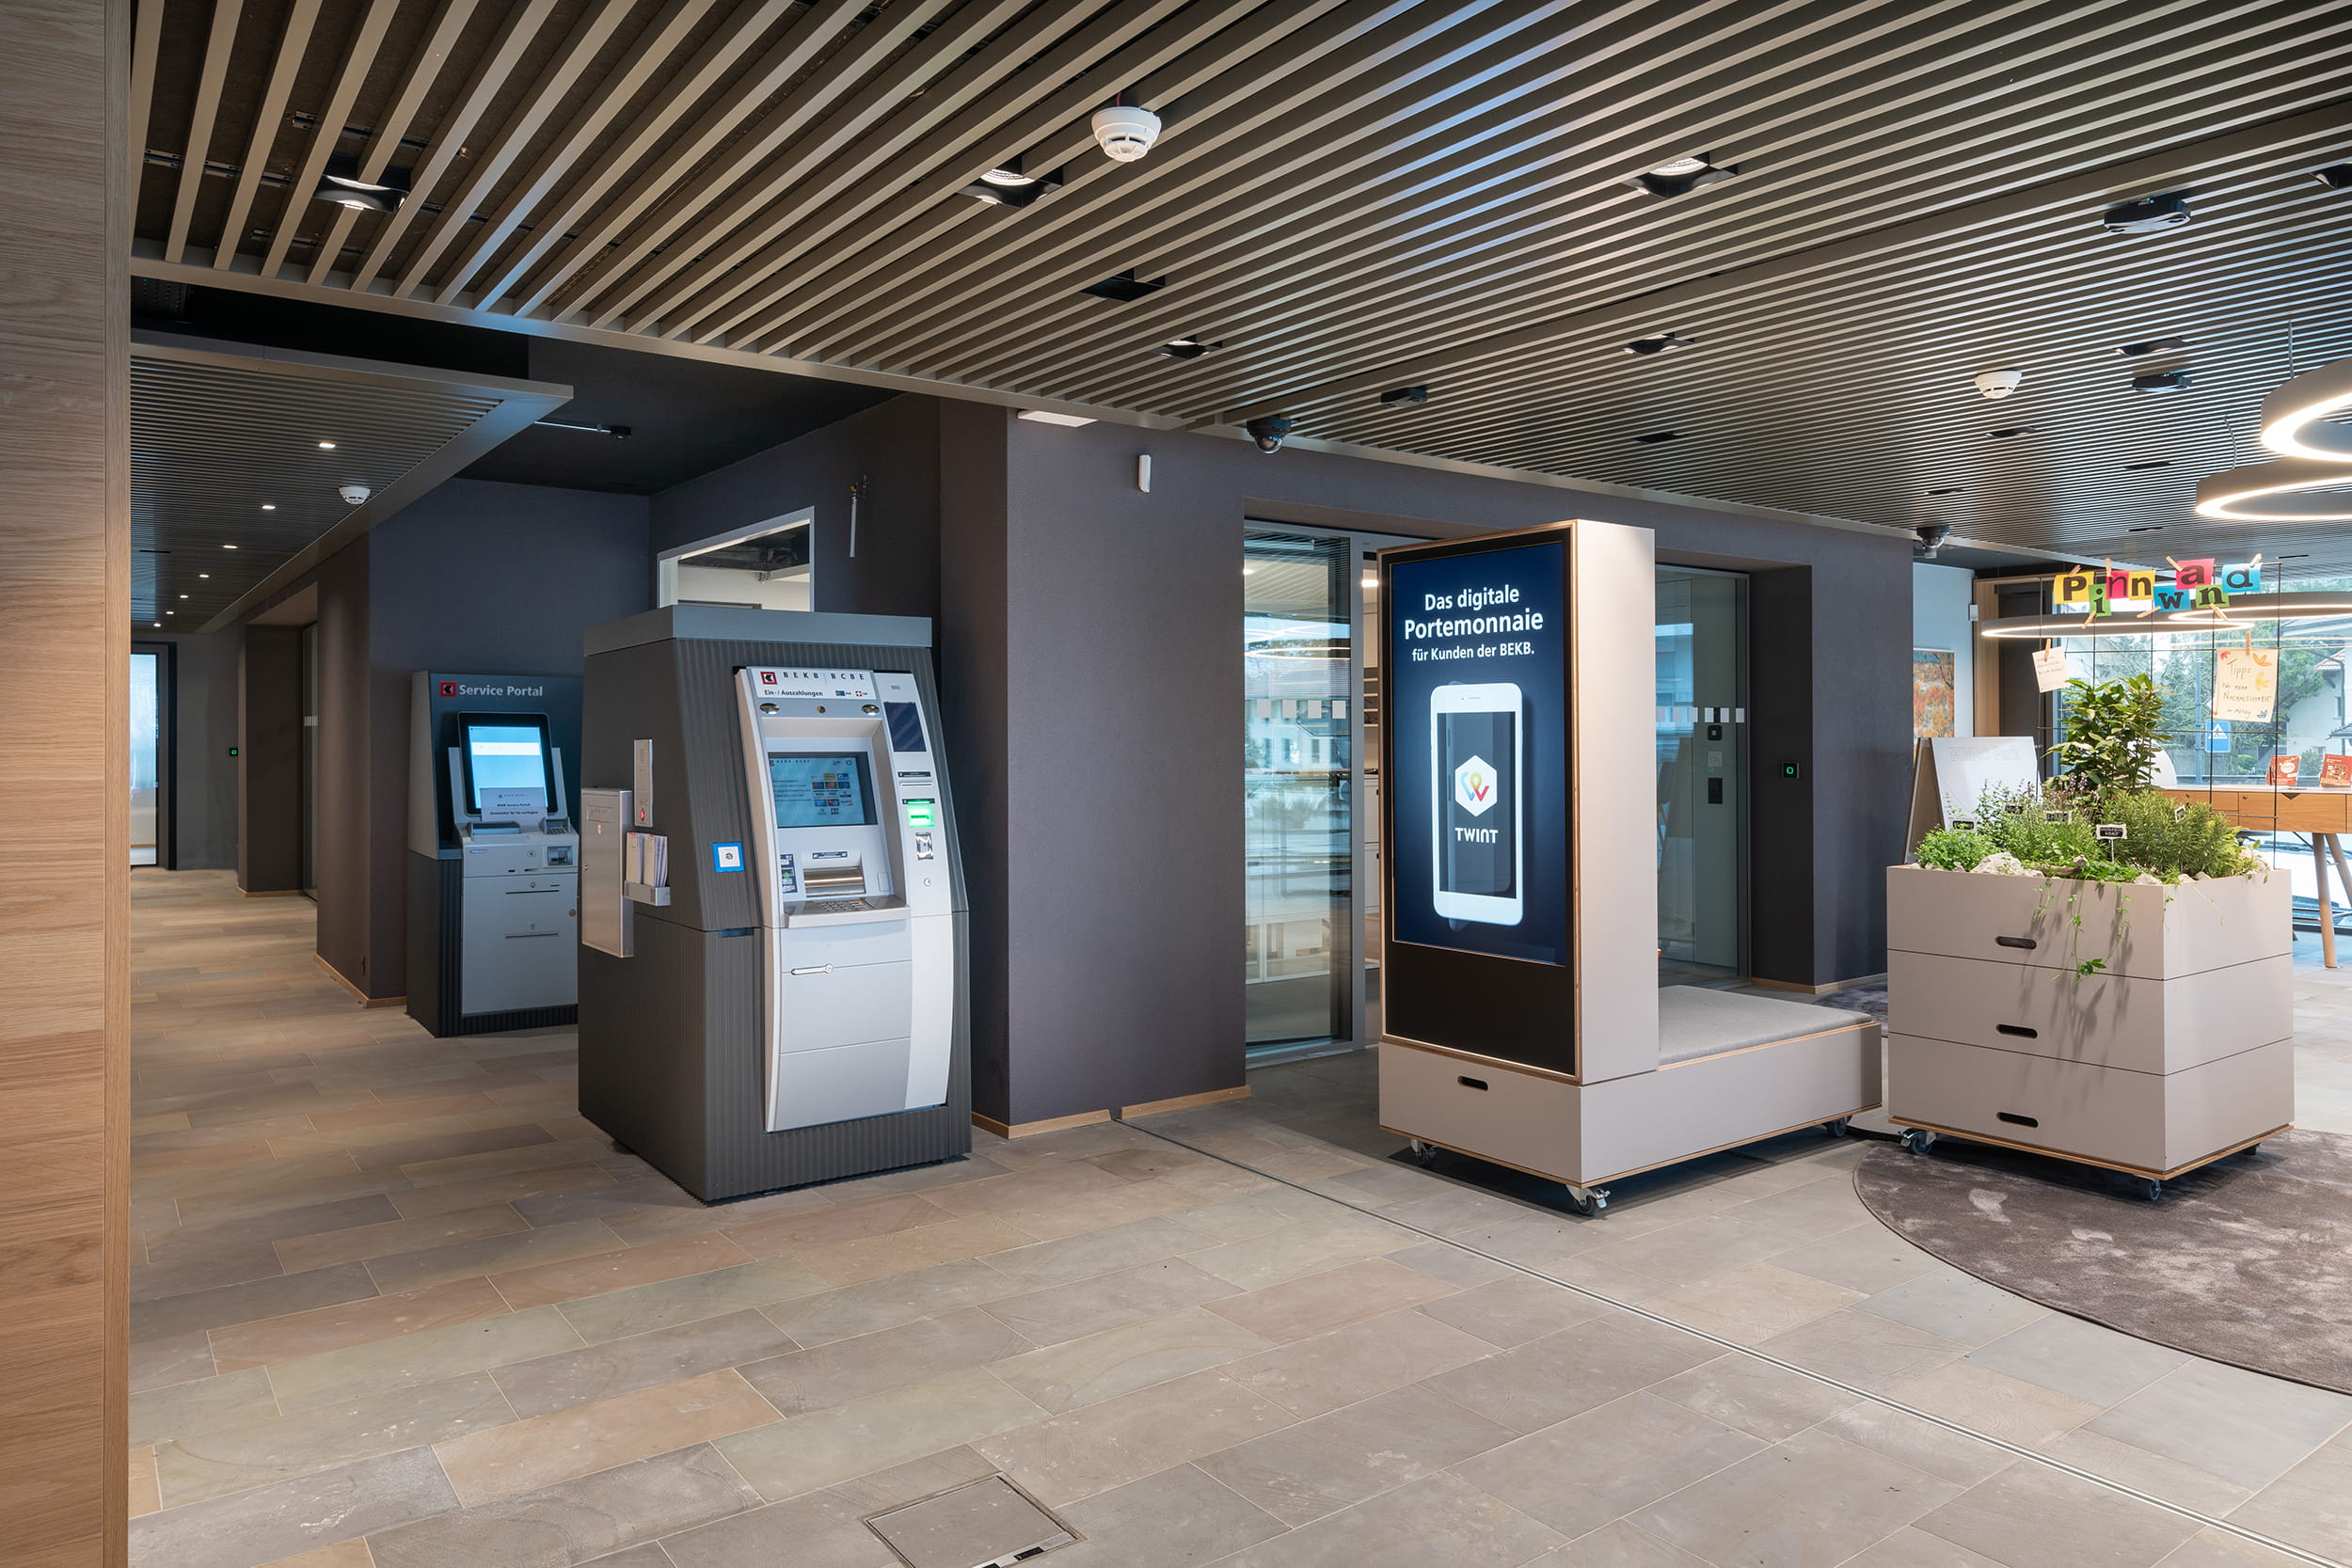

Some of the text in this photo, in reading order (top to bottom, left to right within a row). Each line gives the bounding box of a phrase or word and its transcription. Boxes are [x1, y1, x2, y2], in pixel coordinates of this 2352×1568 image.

[1424, 584, 1520, 611] Das digitale
[1405, 608, 1544, 641] Portemonnaie
[1412, 641, 1535, 661] für Kunden der BEKB.
[458, 685, 543, 697] Service Portal
[781, 689, 823, 698] Auszahlungen
[1454, 827, 1499, 844] TWINT
